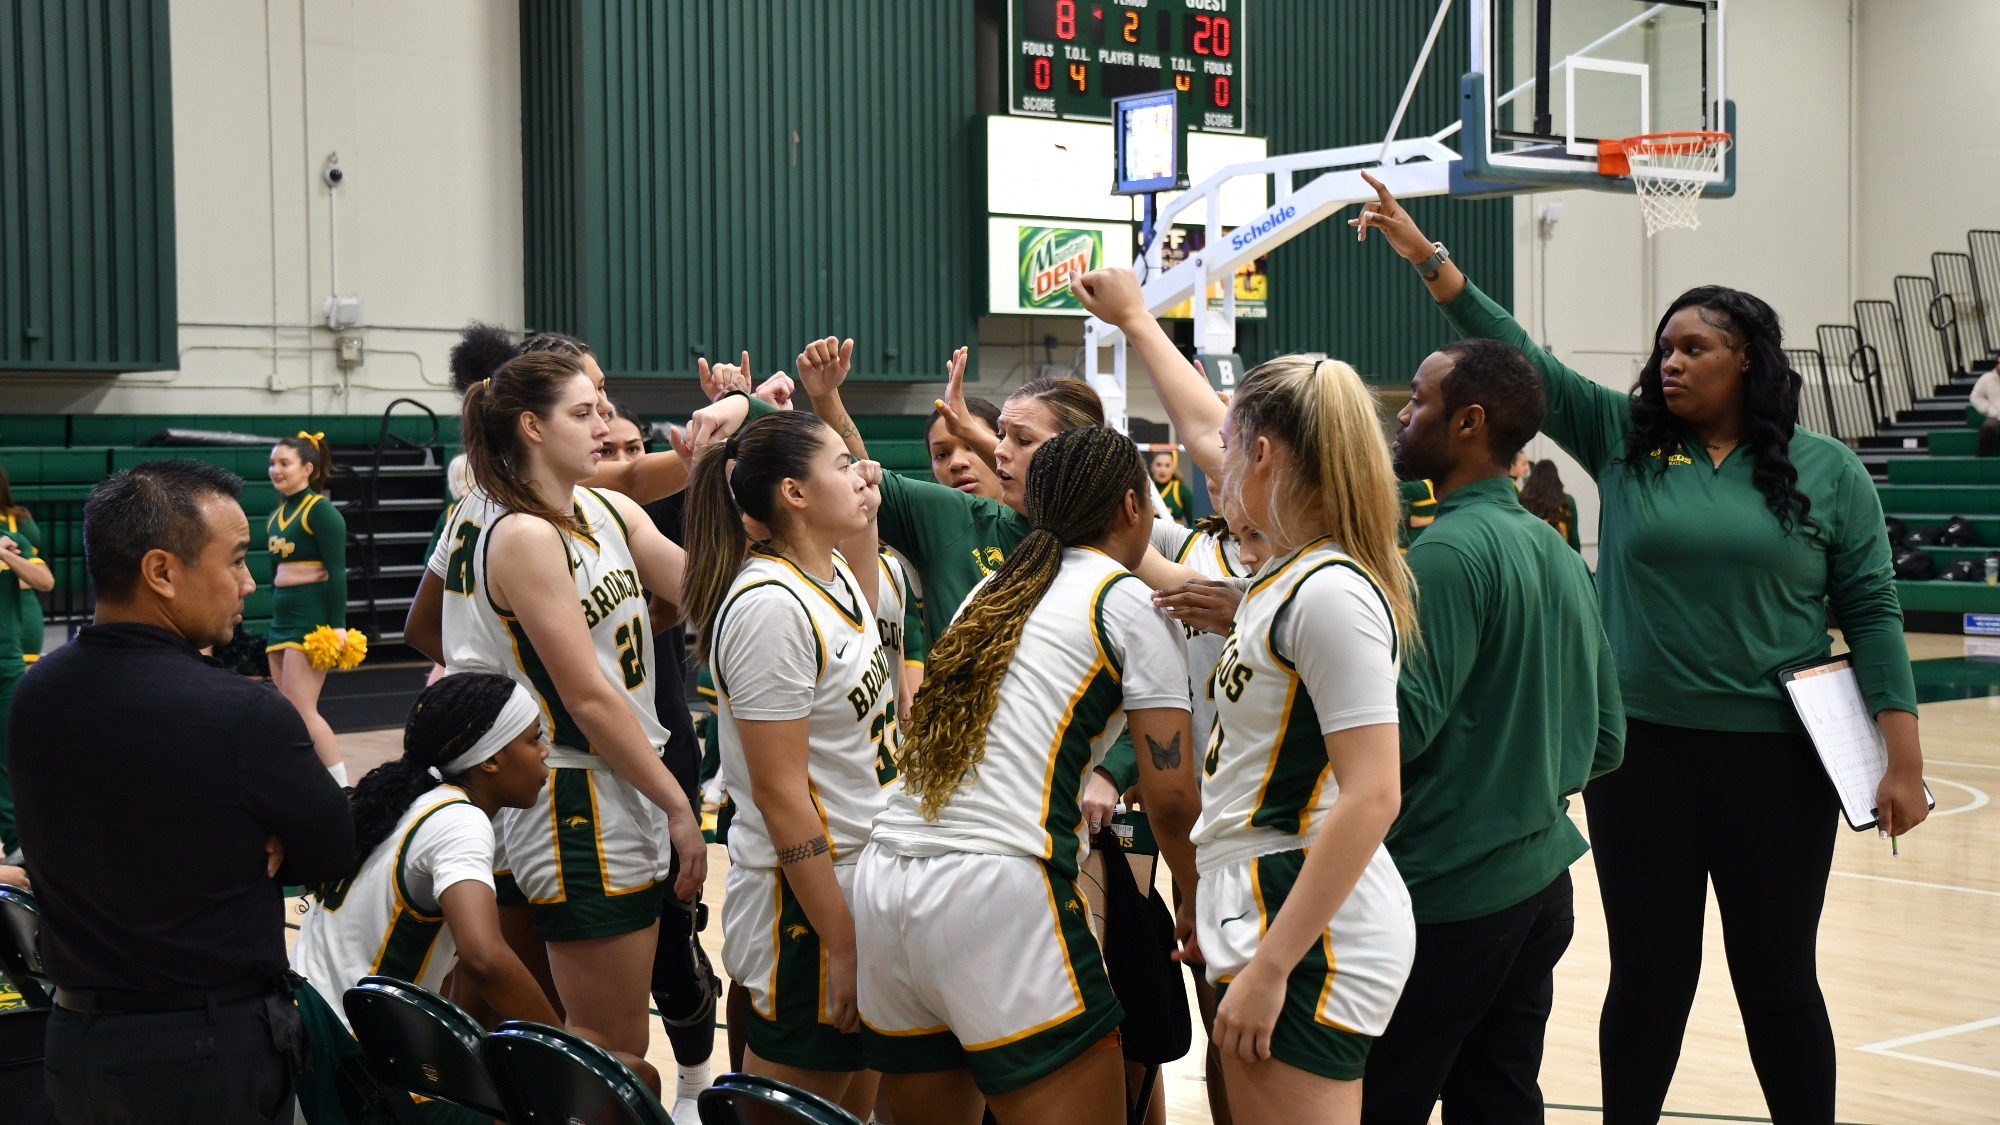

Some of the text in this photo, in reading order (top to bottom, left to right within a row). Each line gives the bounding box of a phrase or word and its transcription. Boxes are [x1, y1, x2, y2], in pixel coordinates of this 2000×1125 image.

[1056, 0, 1076, 40] 8
[1185, 0, 1227, 12] GUEST
[1124, 10, 1139, 43] 2
[1193, 15, 1231, 57] 20
[1021, 41, 1054, 57] FOULS
[1098, 49, 1162, 69] PLAYER FOUL
[1034, 58, 1051, 91] 0
[1069, 63, 1086, 92] 4
[1203, 60, 1233, 76] FOULS
[1022, 96, 1056, 112] SCORE
[1214, 76, 1230, 107] 0
[1203, 112, 1234, 128] SCORE
[1231, 205, 1296, 251] Schelde
[580, 568, 645, 631] BRONCO
[613, 613, 647, 692] 21
